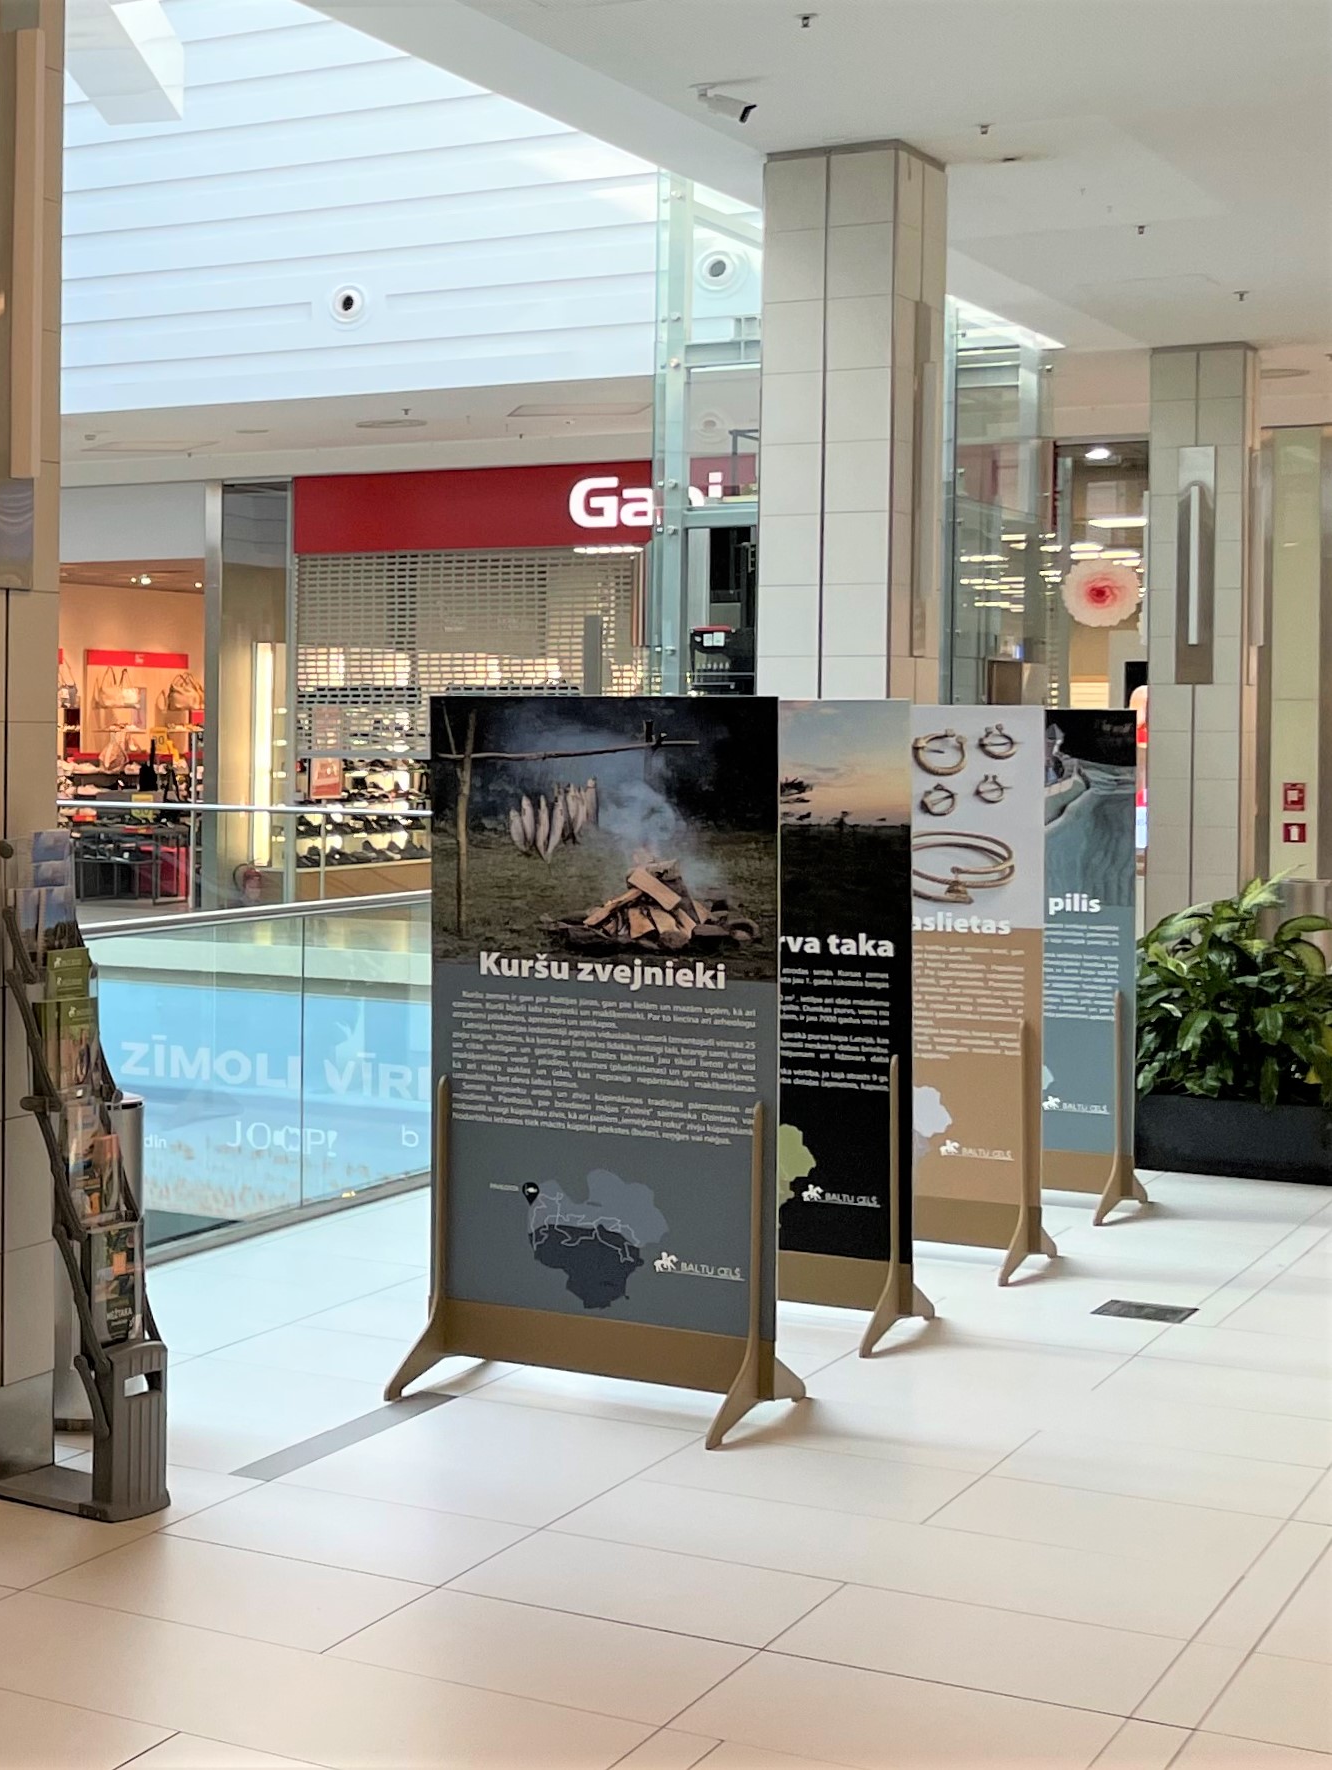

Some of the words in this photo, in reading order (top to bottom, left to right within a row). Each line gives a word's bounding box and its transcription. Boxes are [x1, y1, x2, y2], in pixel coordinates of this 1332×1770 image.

[1048, 893, 1101, 914] pilis
[827, 933, 895, 957] taka
[479, 951, 569, 981] Kuršu
[577, 958, 727, 991] zvejnieki
[120, 1035, 301, 1089] ZĪMOLI
[227, 1120, 337, 1157] JOOP!
